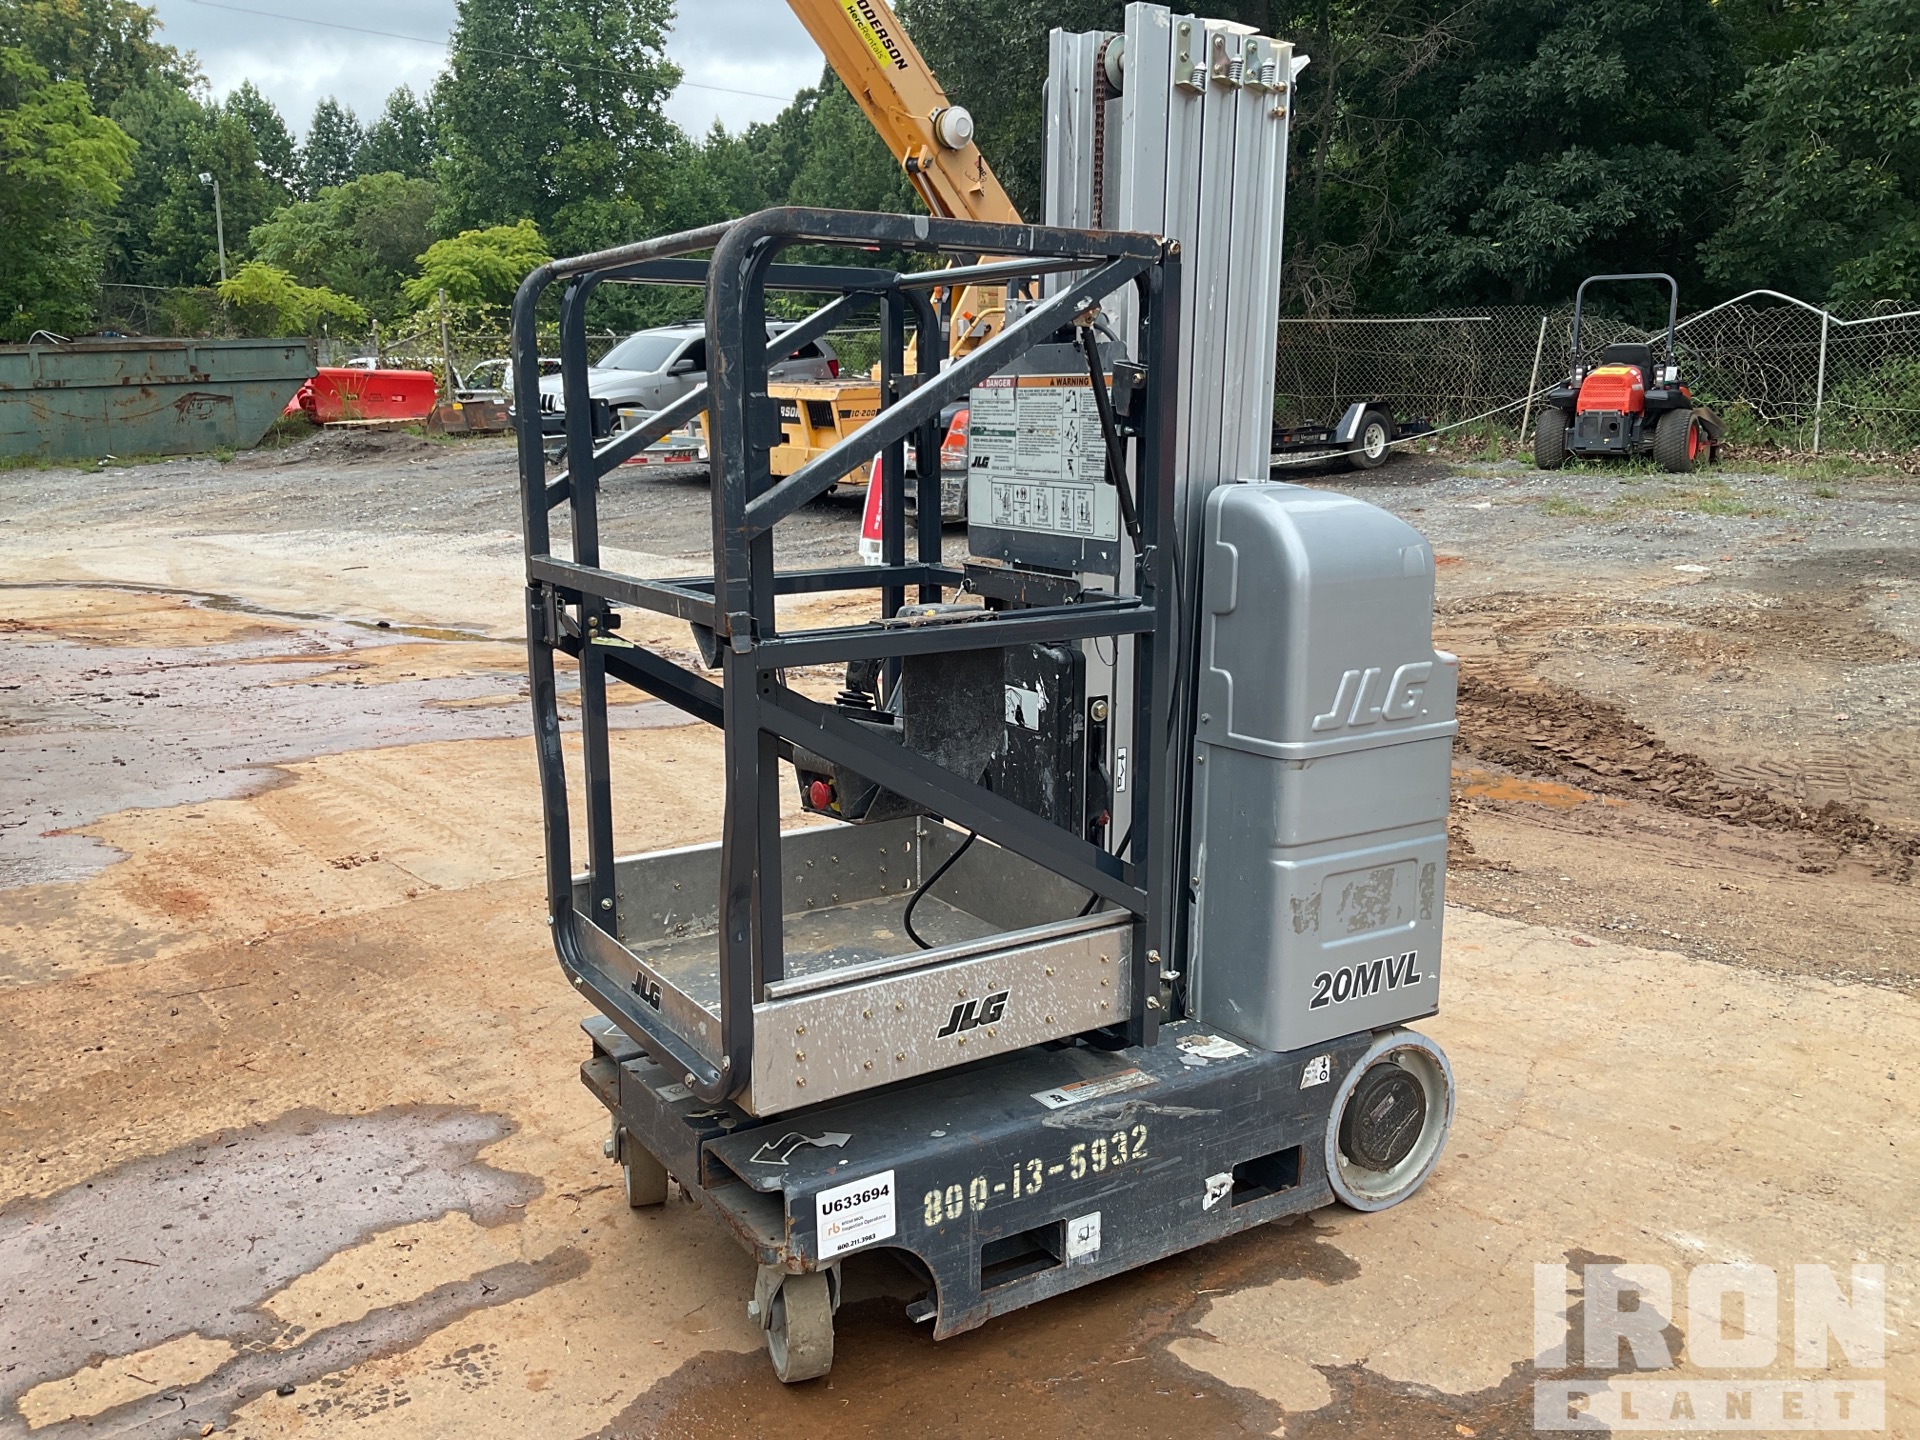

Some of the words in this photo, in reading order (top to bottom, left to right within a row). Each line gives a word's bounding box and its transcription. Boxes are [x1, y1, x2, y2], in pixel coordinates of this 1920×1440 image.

[847, 6, 883, 59] HercRentals
[986, 378, 1011, 387] DANGER
[1056, 377, 1089, 386] WARNING
[971, 455, 990, 468] JLG
[1311, 661, 1433, 731] JLG
[631, 969, 663, 1013] JLG
[1309, 951, 1422, 1010] 20MVL
[936, 989, 1011, 1040] JLG
[822, 1184, 889, 1215] U633694
[828, 1222, 840, 1236] rb
